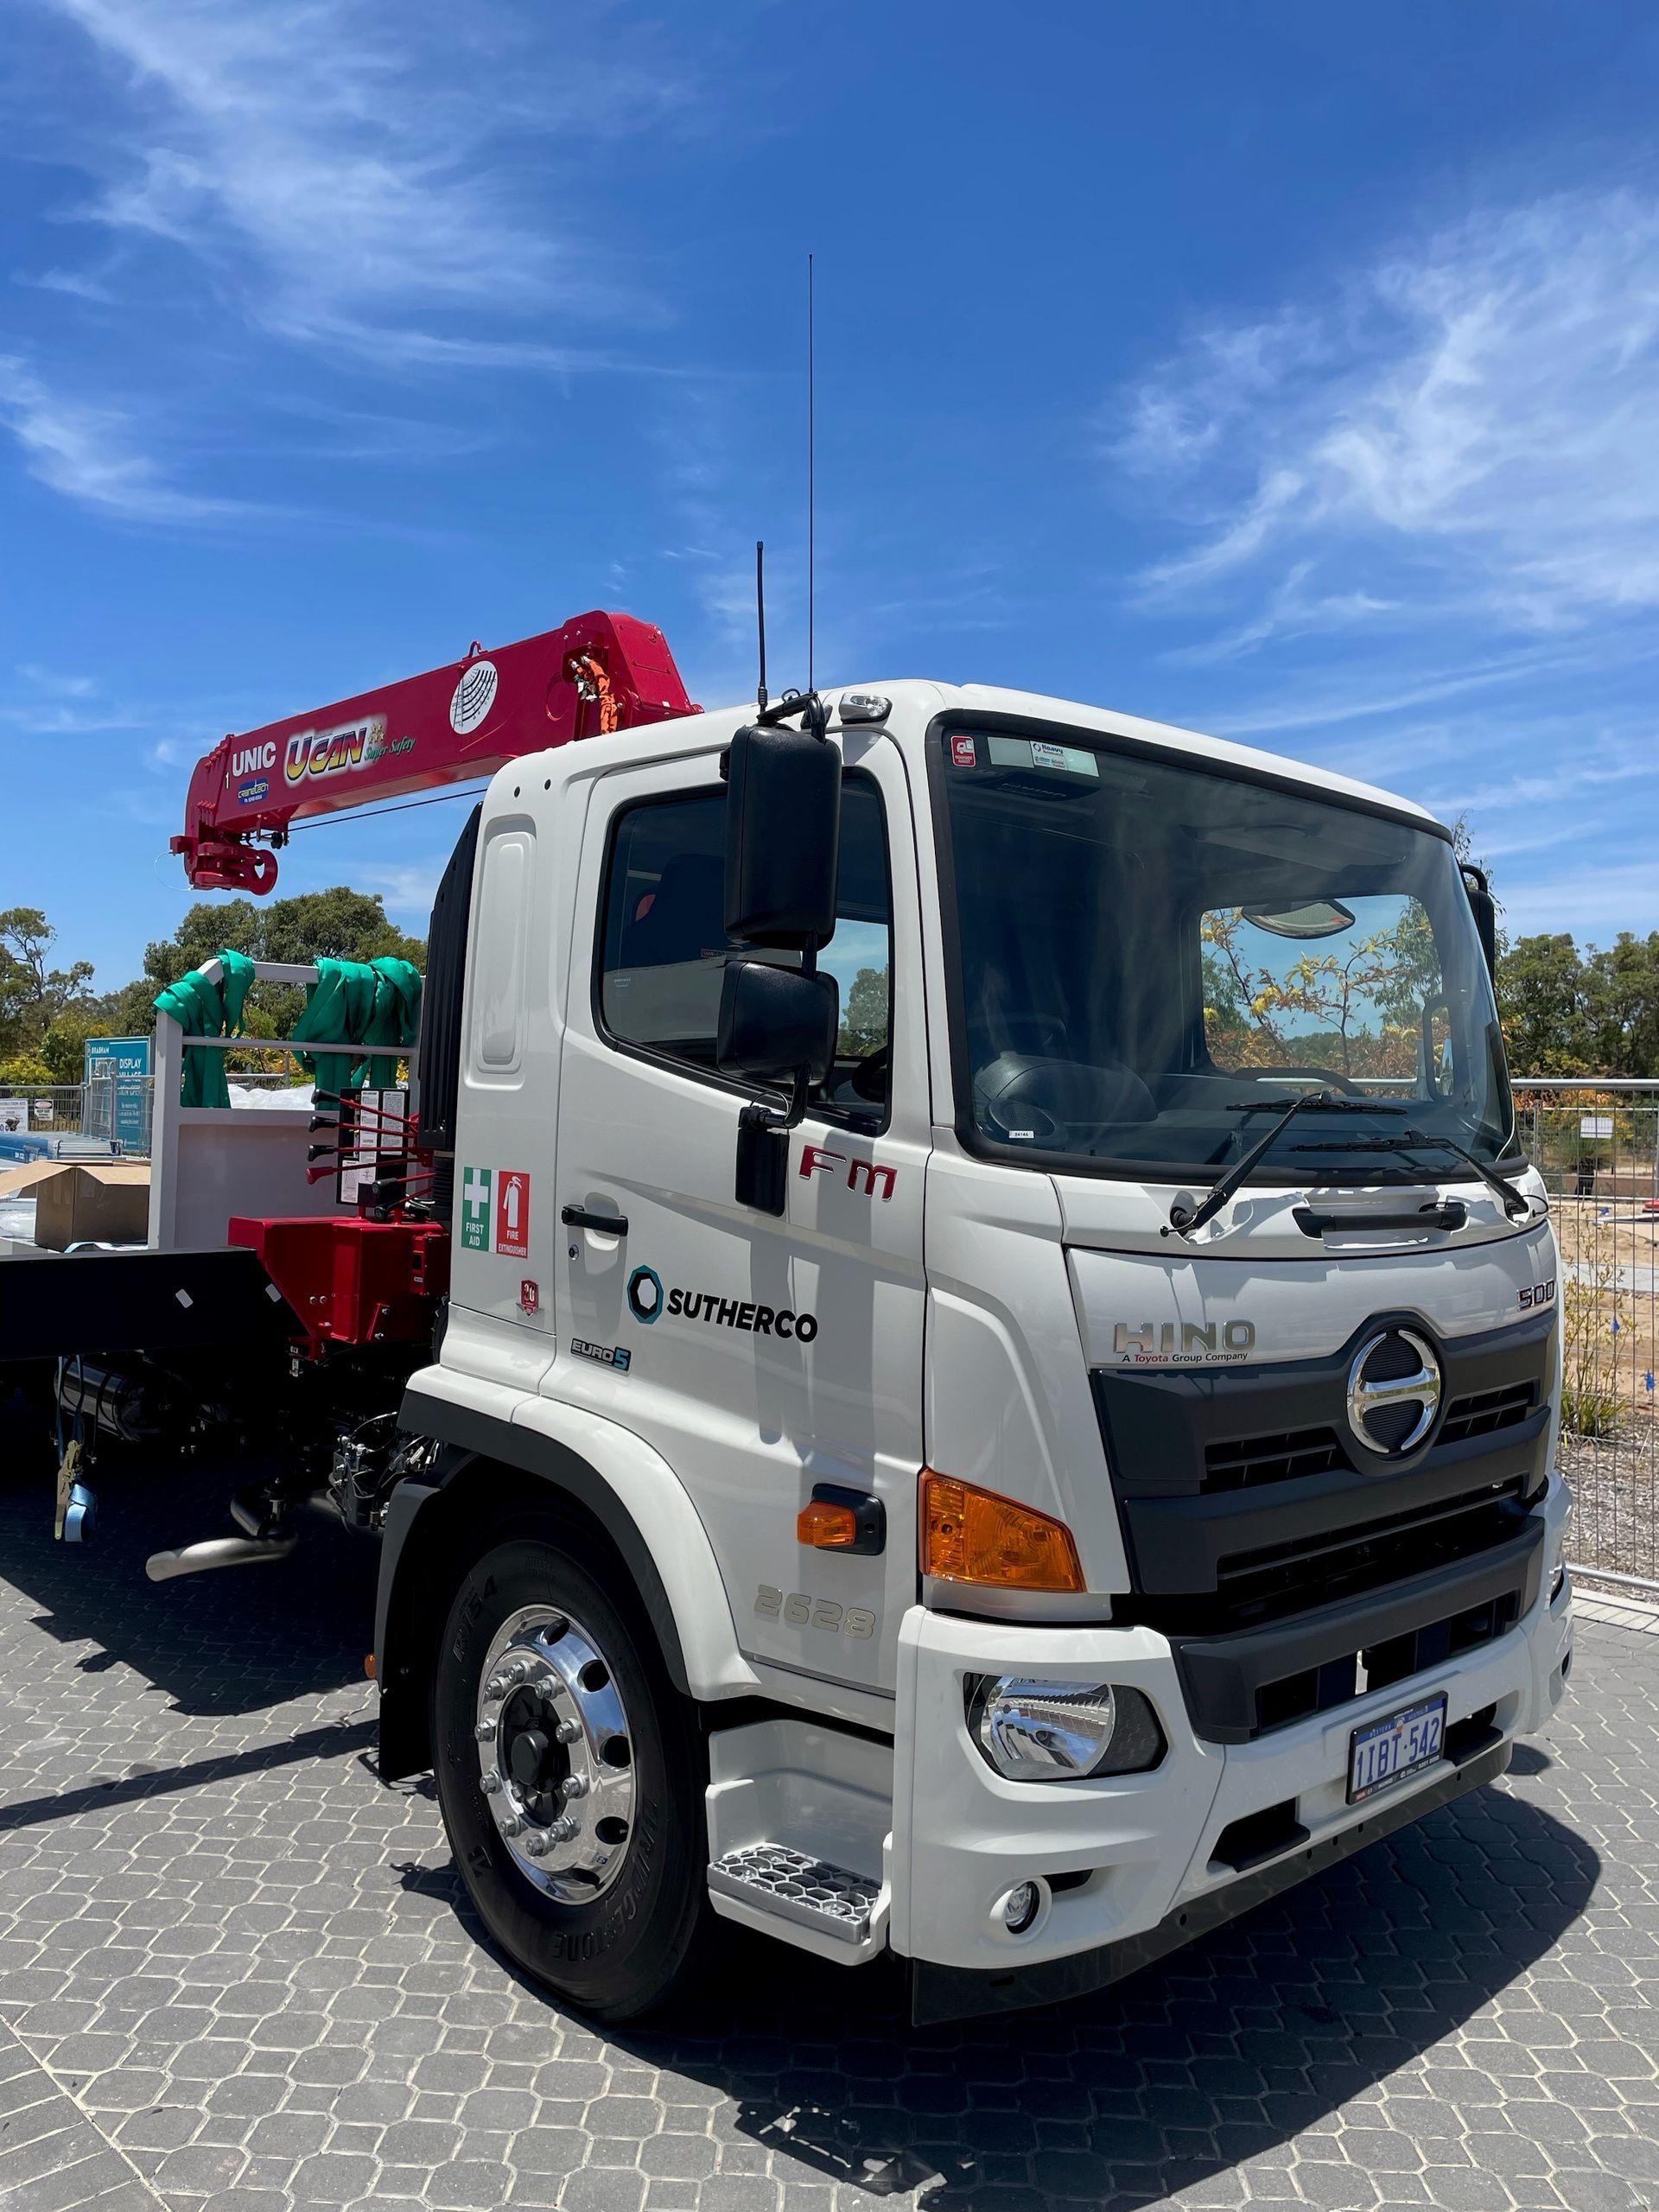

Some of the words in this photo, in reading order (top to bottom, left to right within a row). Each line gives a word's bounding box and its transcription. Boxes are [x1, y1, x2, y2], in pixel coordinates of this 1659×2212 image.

[232, 741, 276, 777] UNIC
[365, 746, 389, 764] Super
[389, 735, 416, 756] Safety
[118, 1058, 142, 1070] DISPLAY
[465, 1221, 484, 1235] FIRST
[506, 1230, 519, 1241] FIRE
[468, 1235, 480, 1247] AID
[498, 1243, 527, 1256] EXTINGUISHER
[1516, 1278, 1554, 1313] 500
[666, 1287, 818, 1343] SUTHERCO
[1113, 1319, 1256, 1354] HINO
[1122, 1354, 1131, 1363] A
[1134, 1354, 1169, 1364] Toyota
[1172, 1353, 1203, 1363] Group
[1205, 1352, 1249, 1362] Company
[753, 1584, 876, 1640] 2628
